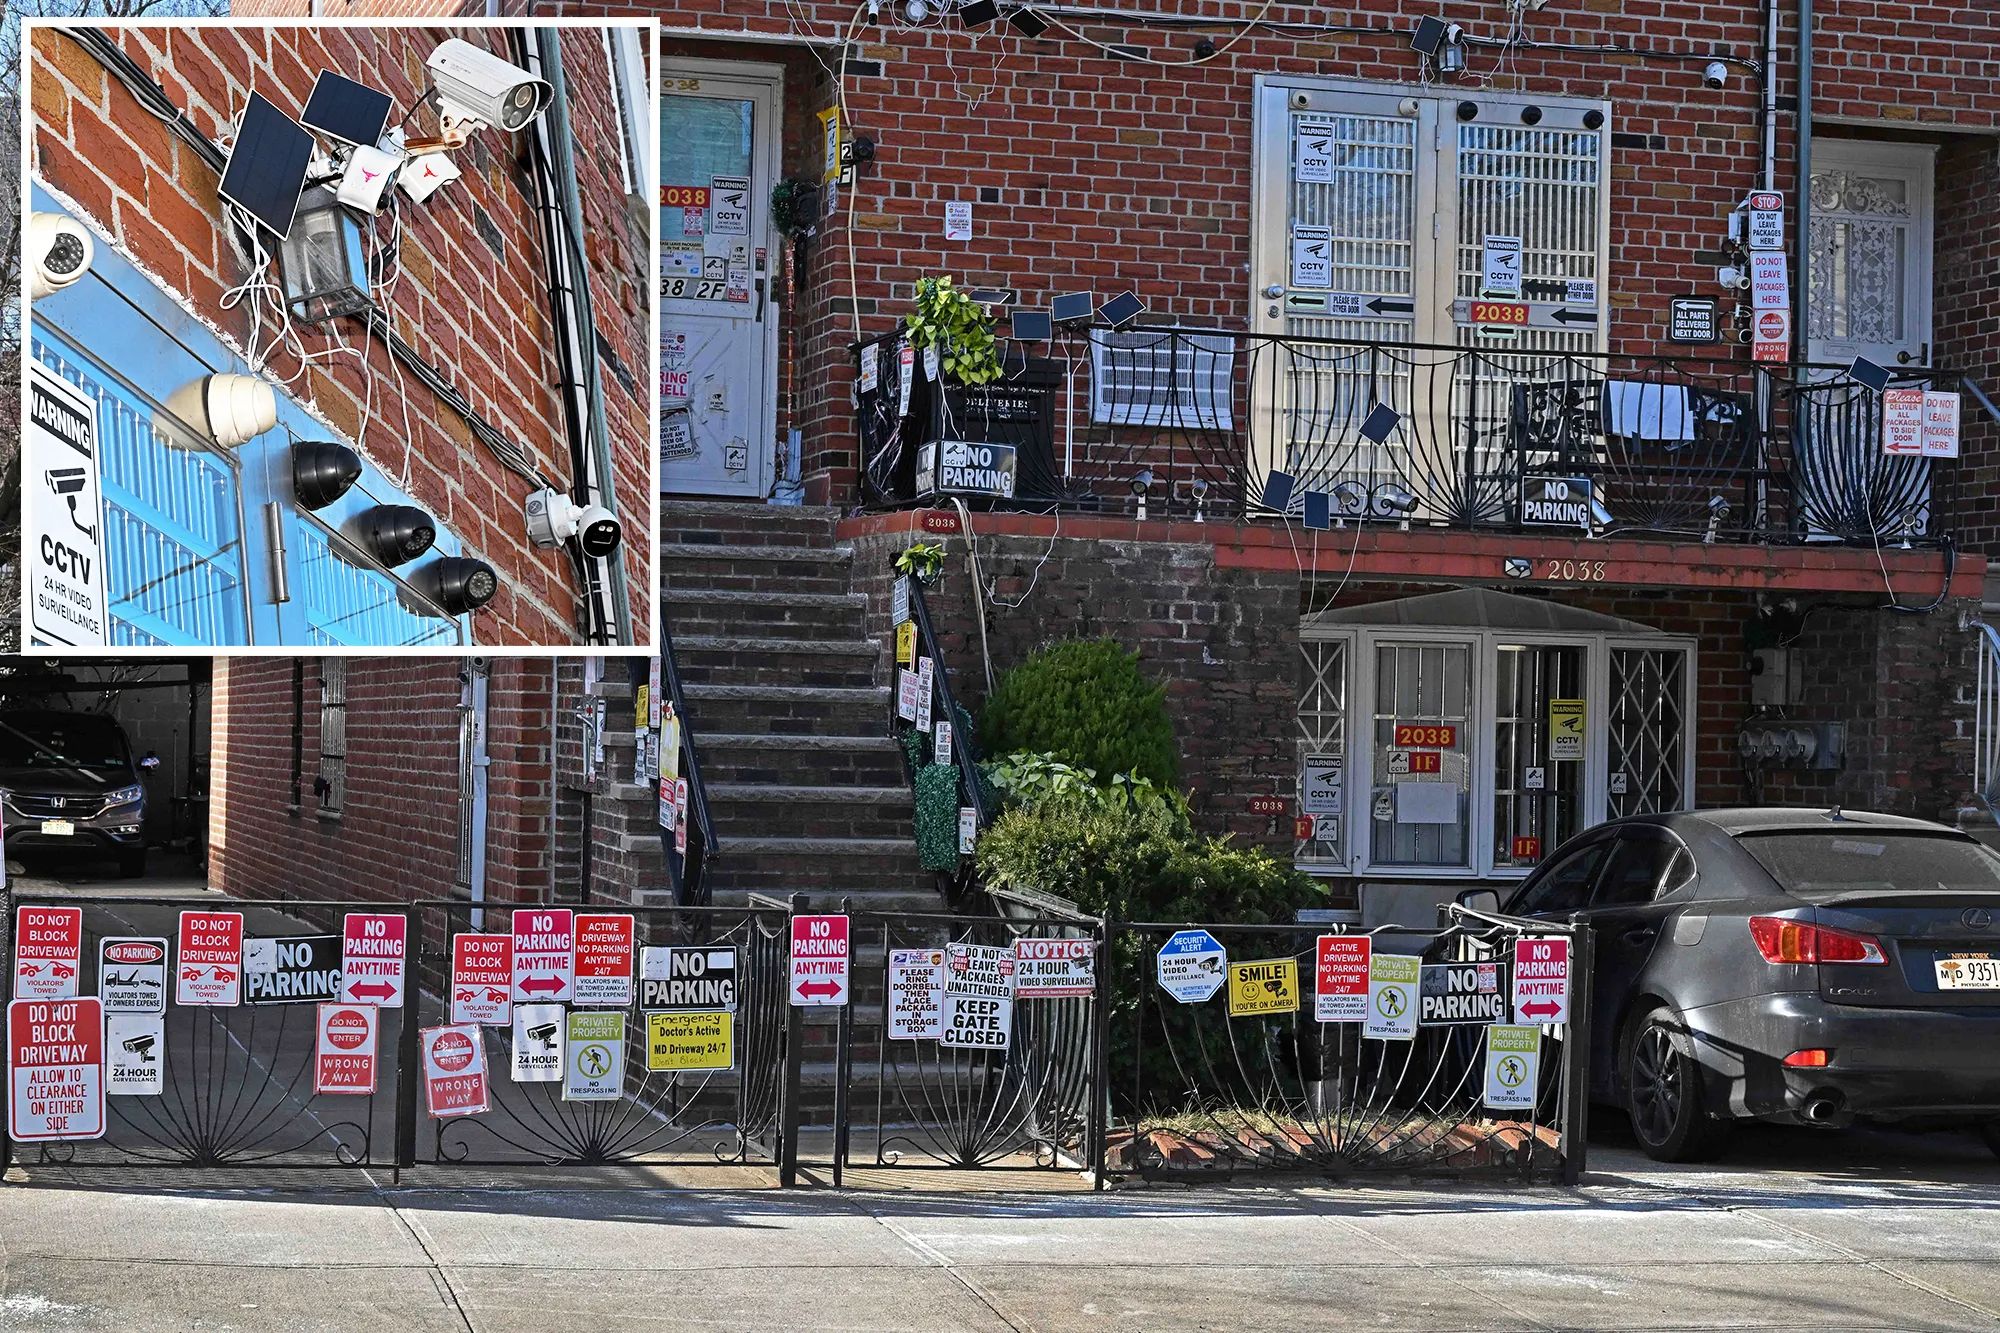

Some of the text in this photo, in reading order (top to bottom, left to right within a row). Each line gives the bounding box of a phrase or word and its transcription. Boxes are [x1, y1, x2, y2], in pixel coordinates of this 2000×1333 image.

[1300, 128, 1330, 136] WARNING
[714, 181, 746, 190] WARNING
[1758, 196, 1776, 208] STOP
[1297, 232, 1328, 240] WARNING
[696, 282, 726, 298] 2F
[1476, 305, 1524, 320] 2038
[1887, 392, 1922, 403] Please
[1939, 400, 1954, 408] NOT
[1929, 413, 1951, 422] LEAVE
[1924, 426, 1954, 436] PACKAGES
[967, 447, 992, 466] NO
[943, 468, 1010, 490] PARKING
[1544, 482, 1568, 500] NO
[1524, 501, 1587, 522] PARKING
[928, 518, 955, 528] 2038
[41, 534, 90, 585] CCTV
[1548, 560, 1606, 580] 2038
[39, 593, 99, 635] SURVEILLANCE
[1400, 728, 1450, 744] 2038
[1416, 756, 1435, 770] 1F
[1254, 801, 1283, 810] 2038
[28, 915, 70, 926] DO NOT
[191, 920, 232, 931] DO NOT
[532, 915, 553, 932] NO
[364, 920, 386, 937] NO
[588, 923, 619, 931] ACTIVE
[810, 921, 830, 937] NO
[30, 931, 68, 941] BLOCK
[192, 935, 230, 946] BLOCK
[516, 933, 570, 950] PARKING
[581, 934, 625, 942] DRIVEWAY
[1174, 936, 1207, 946] SECURITY
[20, 946, 77, 957] DRIVEWAY
[110, 947, 156, 958] NO PARKING
[346, 938, 402, 956] PARKING
[464, 942, 504, 952] DO NOT
[577, 945, 630, 954] NO PARKING
[794, 939, 846, 955] PARKING
[1020, 941, 1094, 959] NOTICE
[1330, 943, 1357, 952] ACTIVE
[1533, 944, 1551, 960] NO
[182, 950, 238, 961] DRIVEWAY
[277, 942, 313, 969] NO
[966, 947, 1000, 961] DO NOT
[1323, 954, 1363, 962] DRIVEWAY
[465, 957, 502, 968] BLOCK
[516, 956, 568, 971] ANYTIME
[584, 956, 621, 965] ANYTIME
[671, 953, 706, 977] NO
[968, 960, 996, 971] LEAVE
[1377, 960, 1411, 969] PRIVATE
[347, 962, 400, 975] ANYTIME
[594, 967, 611, 976] 24/7
[795, 961, 844, 975] ANYTIME
[1019, 962, 1069, 975] 24 HOUR
[1163, 966, 1187, 974] VIDEO
[1239, 965, 1287, 982] SMILE!
[1320, 964, 1367, 973] NO PARKING
[1517, 962, 1566, 976] PARKING
[456, 972, 510, 983] DRIVEWAY
[955, 970, 1006, 985] PACKAGES
[1326, 975, 1360, 983] ANYTIME
[1372, 970, 1415, 979] PROPERTY
[1448, 969, 1478, 992] NO
[249, 969, 342, 998] PARKING
[1020, 976, 1093, 986] VIDEO SURVEILLANCE
[644, 979, 733, 1006] PARKING
[1335, 985, 1351, 993] 24/7
[1518, 983, 1564, 995] ANYTIME
[956, 1000, 1000, 1015] KEEP
[1422, 994, 1503, 1019] PARKING
[29, 1004, 77, 1023] DO NOT
[577, 1018, 614, 1027] PRIVATE
[651, 1014, 721, 1028] Emergency
[953, 1014, 1000, 1030] GATE
[32, 1024, 76, 1042] BLOCK
[572, 1028, 619, 1037] PROPERTY
[660, 1026, 720, 1037] Doctor's Active
[945, 1029, 1006, 1045] CLOSED
[1497, 1030, 1530, 1039] PRIVATE
[654, 1043, 726, 1056] MD Driveway 24/7
[1492, 1039, 1535, 1049] PROPERTY
[21, 1044, 87, 1064] DRIVEWAY
[518, 1056, 558, 1064] 24 HOUR
[324, 1059, 369, 1069] WRONG
[334, 1073, 358, 1083] WAY
[27, 1084, 87, 1099] CLEARANCE
[433, 1080, 479, 1092] WRONG
[445, 1094, 470, 1106] WAY
[31, 1100, 83, 1115] ON EITHER
[46, 1116, 68, 1130] SIDE
